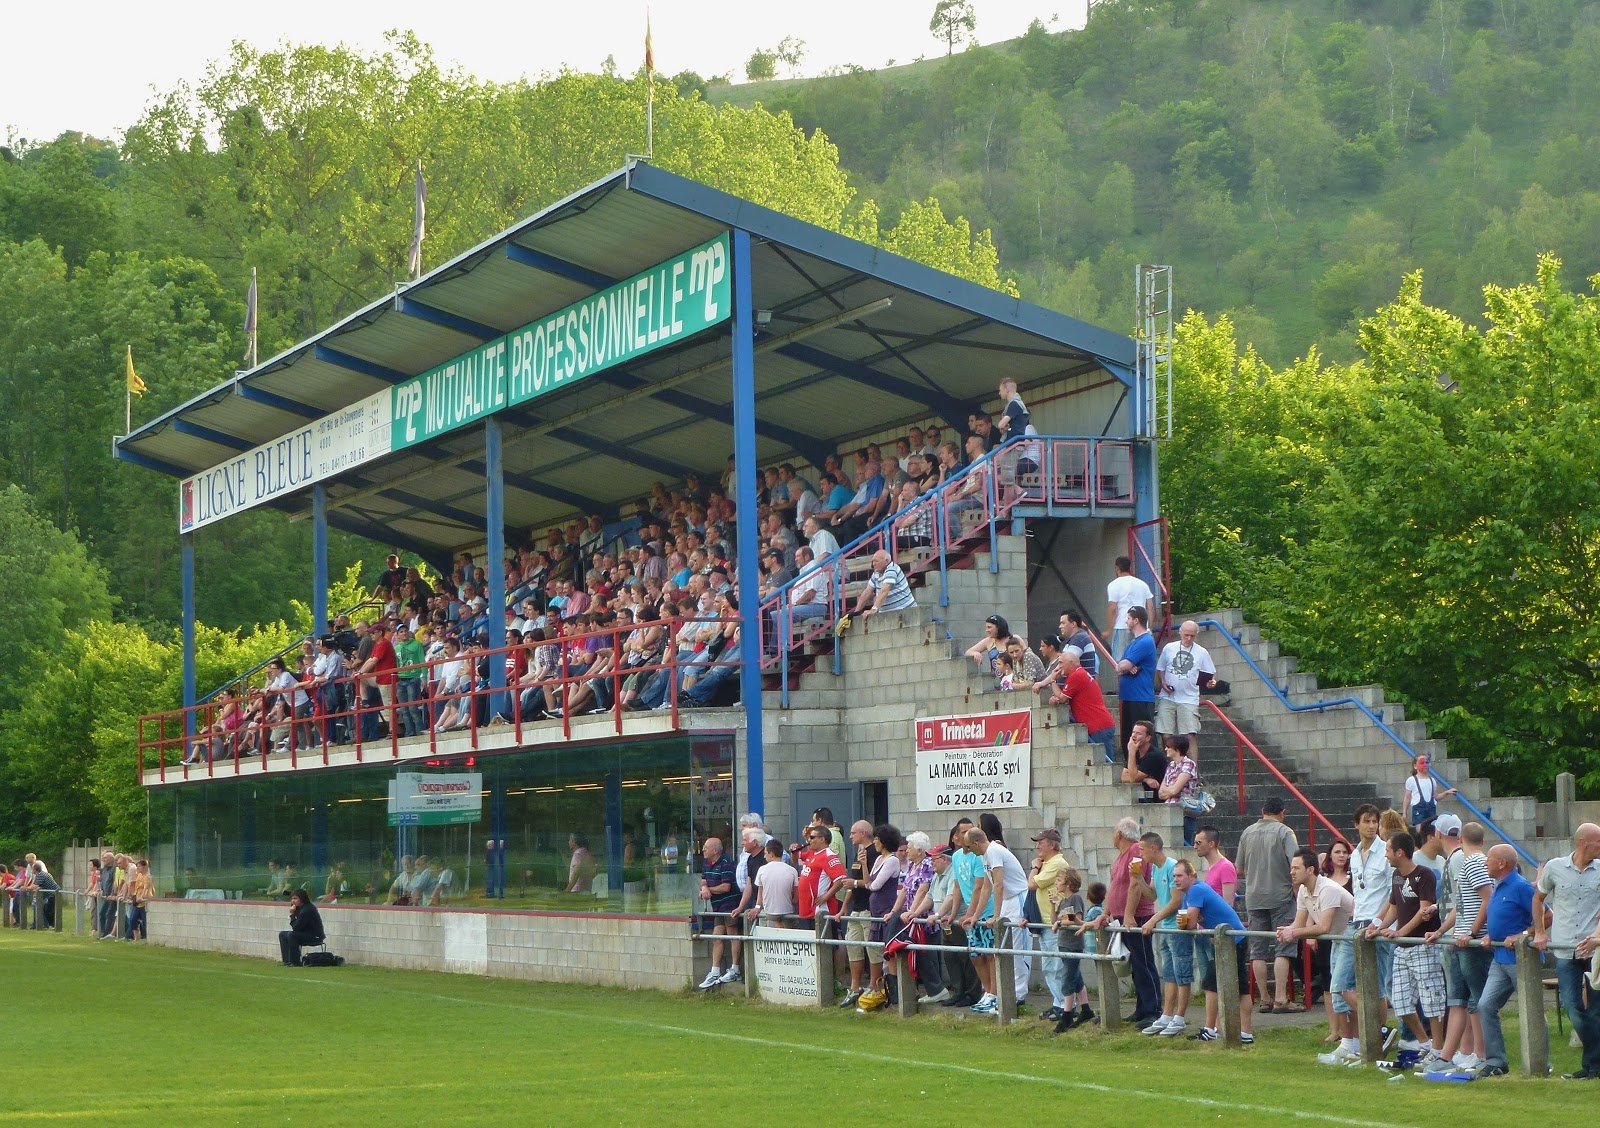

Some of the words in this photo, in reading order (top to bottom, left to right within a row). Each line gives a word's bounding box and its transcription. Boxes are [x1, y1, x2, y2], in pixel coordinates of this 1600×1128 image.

[424, 341, 505, 435] MUTUALITE
[511, 260, 686, 400] PROFESSIONNELLE
[197, 457, 246, 523] LIGNE
[254, 428, 314, 500] BLEUE
[941, 719, 986, 741] Trimetal
[944, 751, 968, 760] Peinture
[929, 763, 940, 779] LA
[942, 761, 976, 778] MANTIA
[978, 760, 998, 777] C.&S
[1003, 757, 1020, 779] sprl
[936, 794, 951, 806] 04
[954, 793, 976, 806] 240
[980, 792, 995, 805] 24
[999, 791, 1014, 803] 12
[755, 941, 764, 953] LA
[764, 941, 792, 956] MANTIA
[792, 942, 816, 957] SPRL
